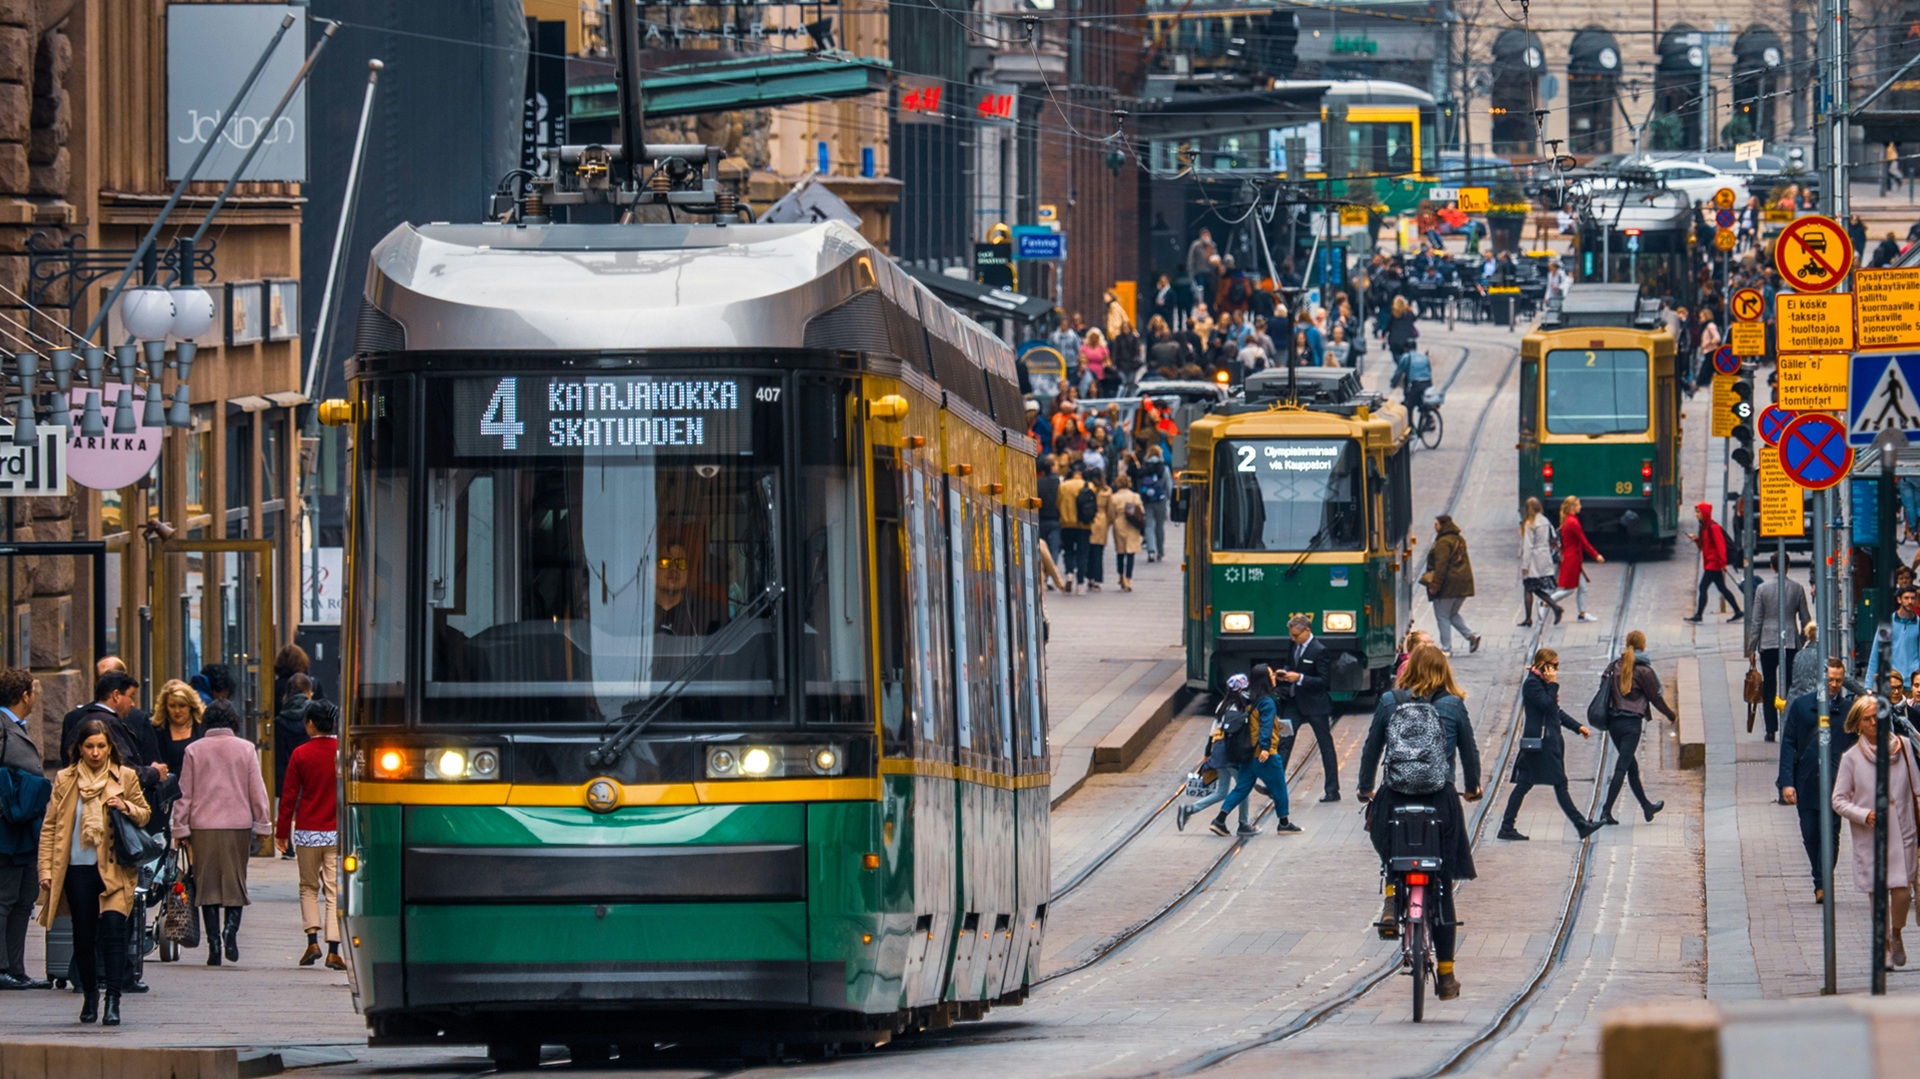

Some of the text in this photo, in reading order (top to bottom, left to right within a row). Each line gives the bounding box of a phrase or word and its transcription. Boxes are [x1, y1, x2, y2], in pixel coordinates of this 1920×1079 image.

[1720, 234, 1732, 245] 20
[1858, 271, 1919, 282] Pysäyttäminen
[1787, 299, 1827, 309] Ei koske
[1859, 293, 1888, 303] sallittu
[1862, 312, 1902, 324] purkaville
[1863, 322, 1912, 334] ajoneuvoille
[1585, 351, 1596, 367] 2
[1780, 359, 1820, 370] Gäller ej
[480, 377, 781, 450] 4 KATAJANOKKA 407
[549, 417, 704, 446] SKATUDDEN
[66, 436, 147, 451] ARIKKA
[1237, 445, 1257, 472] 2
[1269, 460, 1332, 472] via Kauppatori
[1615, 481, 1632, 494] 89
